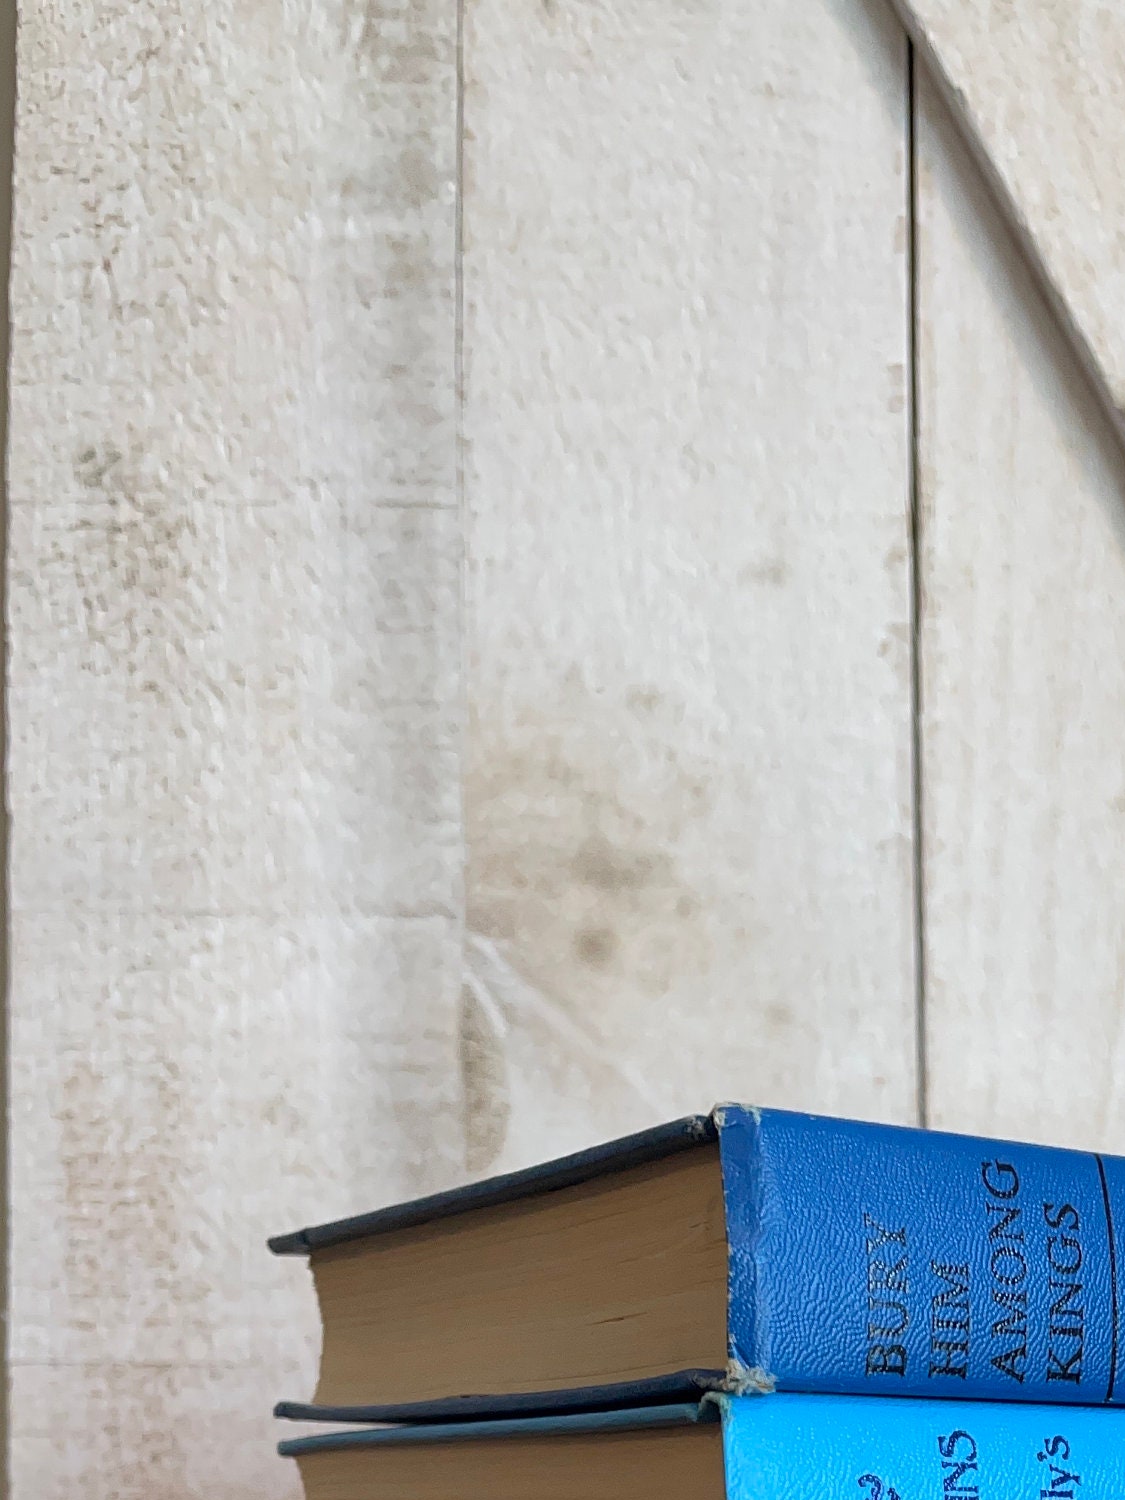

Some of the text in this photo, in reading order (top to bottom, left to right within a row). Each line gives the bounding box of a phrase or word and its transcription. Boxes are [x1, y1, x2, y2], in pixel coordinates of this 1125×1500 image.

[864, 1213, 909, 1378] BURY
[927, 1260, 969, 1380] HIM
[982, 1158, 1028, 1384] AMONG
[1043, 1201, 1085, 1385] KINGS
